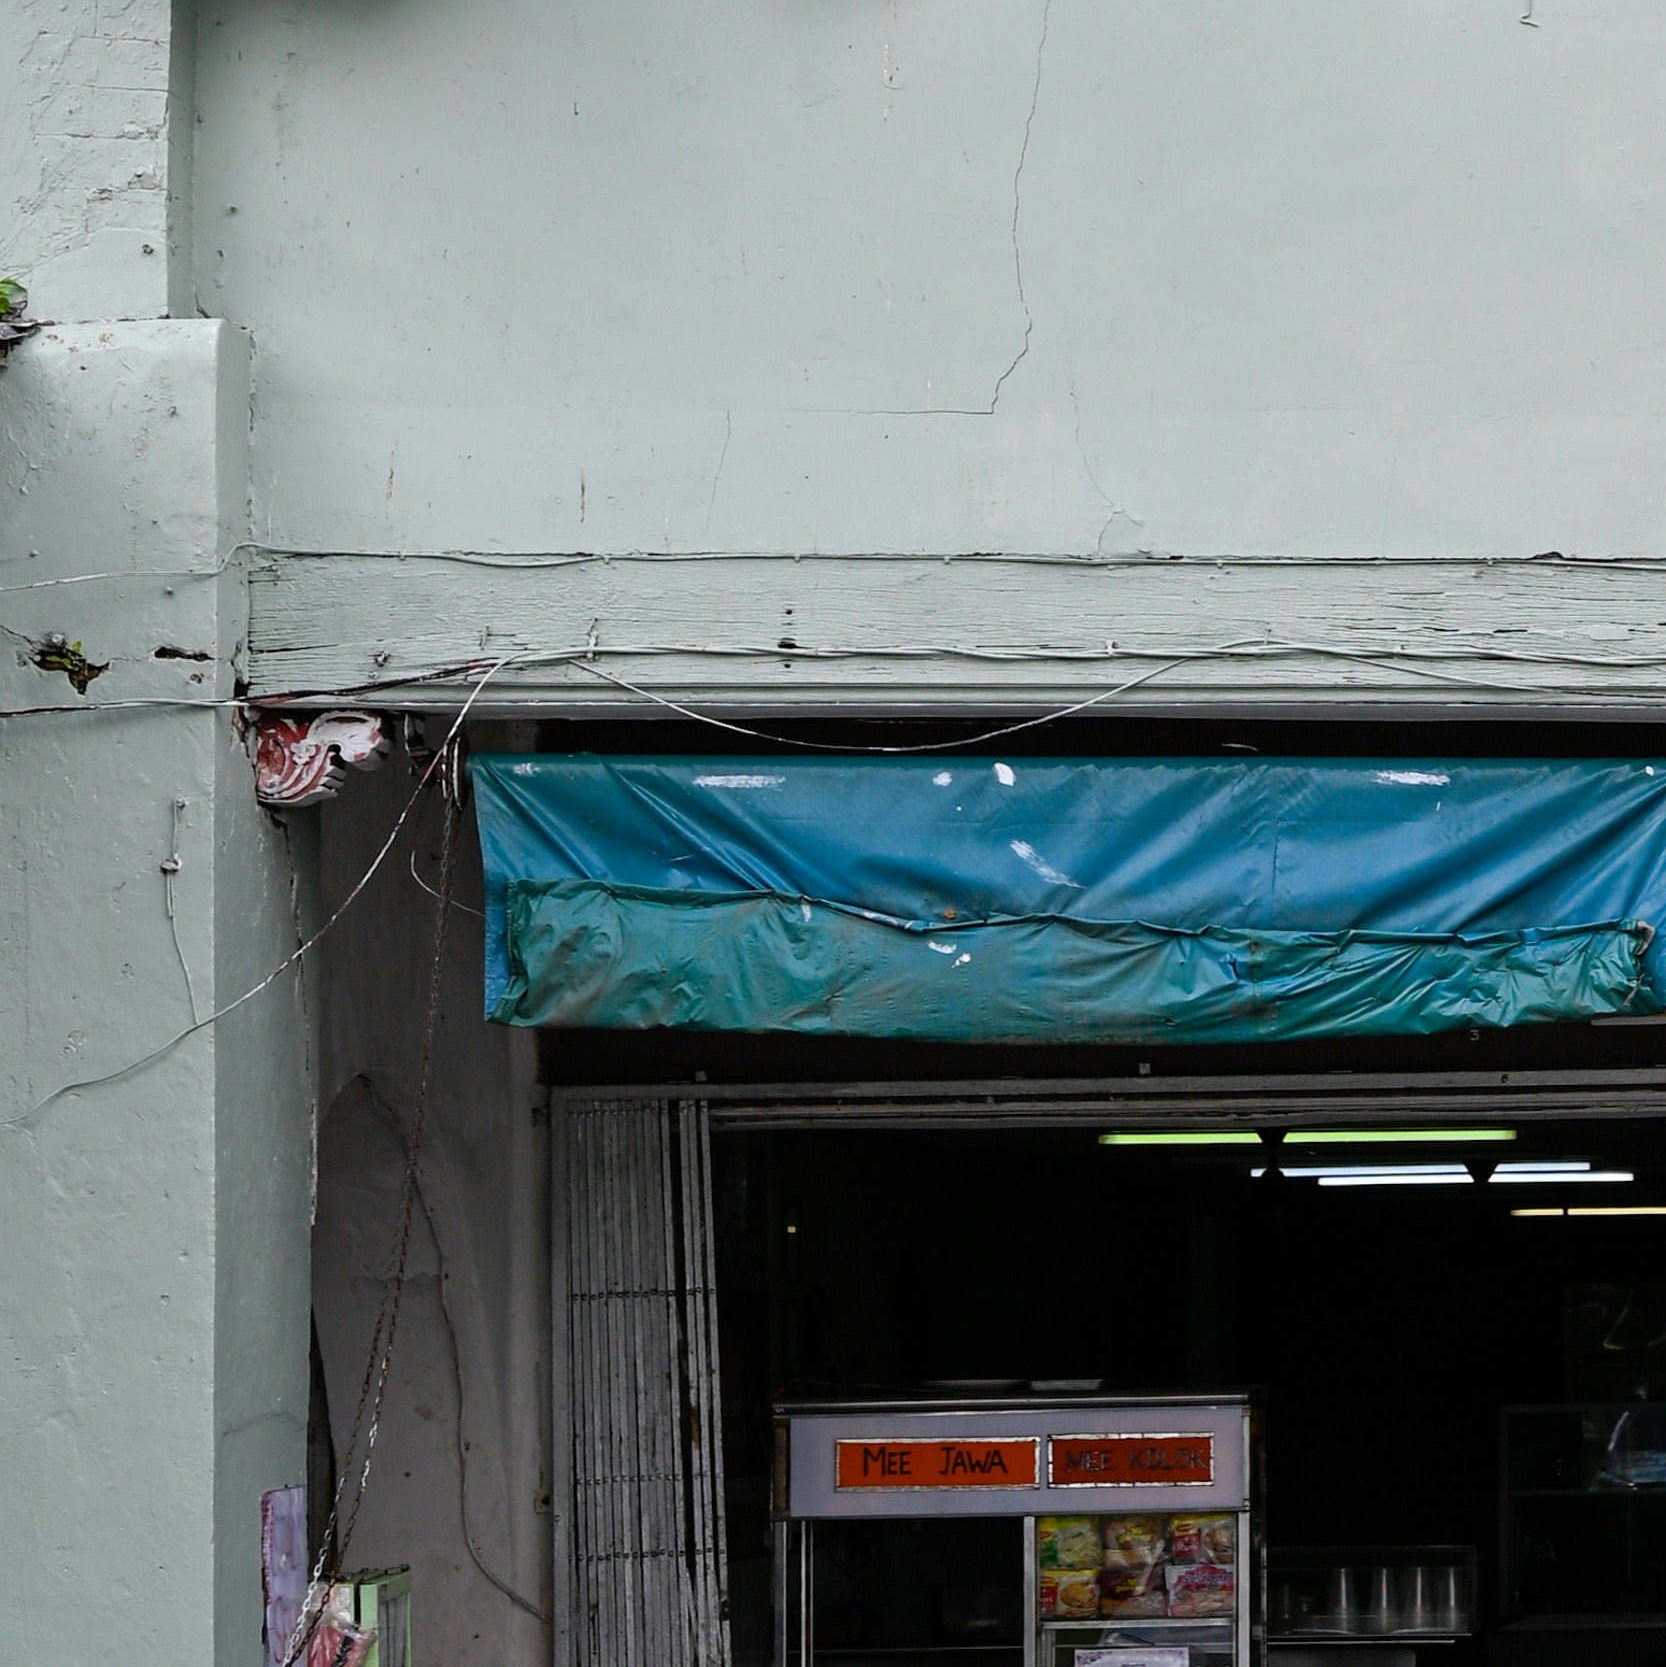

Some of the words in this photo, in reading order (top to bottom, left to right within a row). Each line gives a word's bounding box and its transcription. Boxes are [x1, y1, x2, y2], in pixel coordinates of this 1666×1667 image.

[863, 1446, 912, 1477] MEE
[939, 1446, 1009, 1476] JAWA
[1065, 1447, 1119, 1473] MEE
[1129, 1446, 1208, 1471] KOLOK
